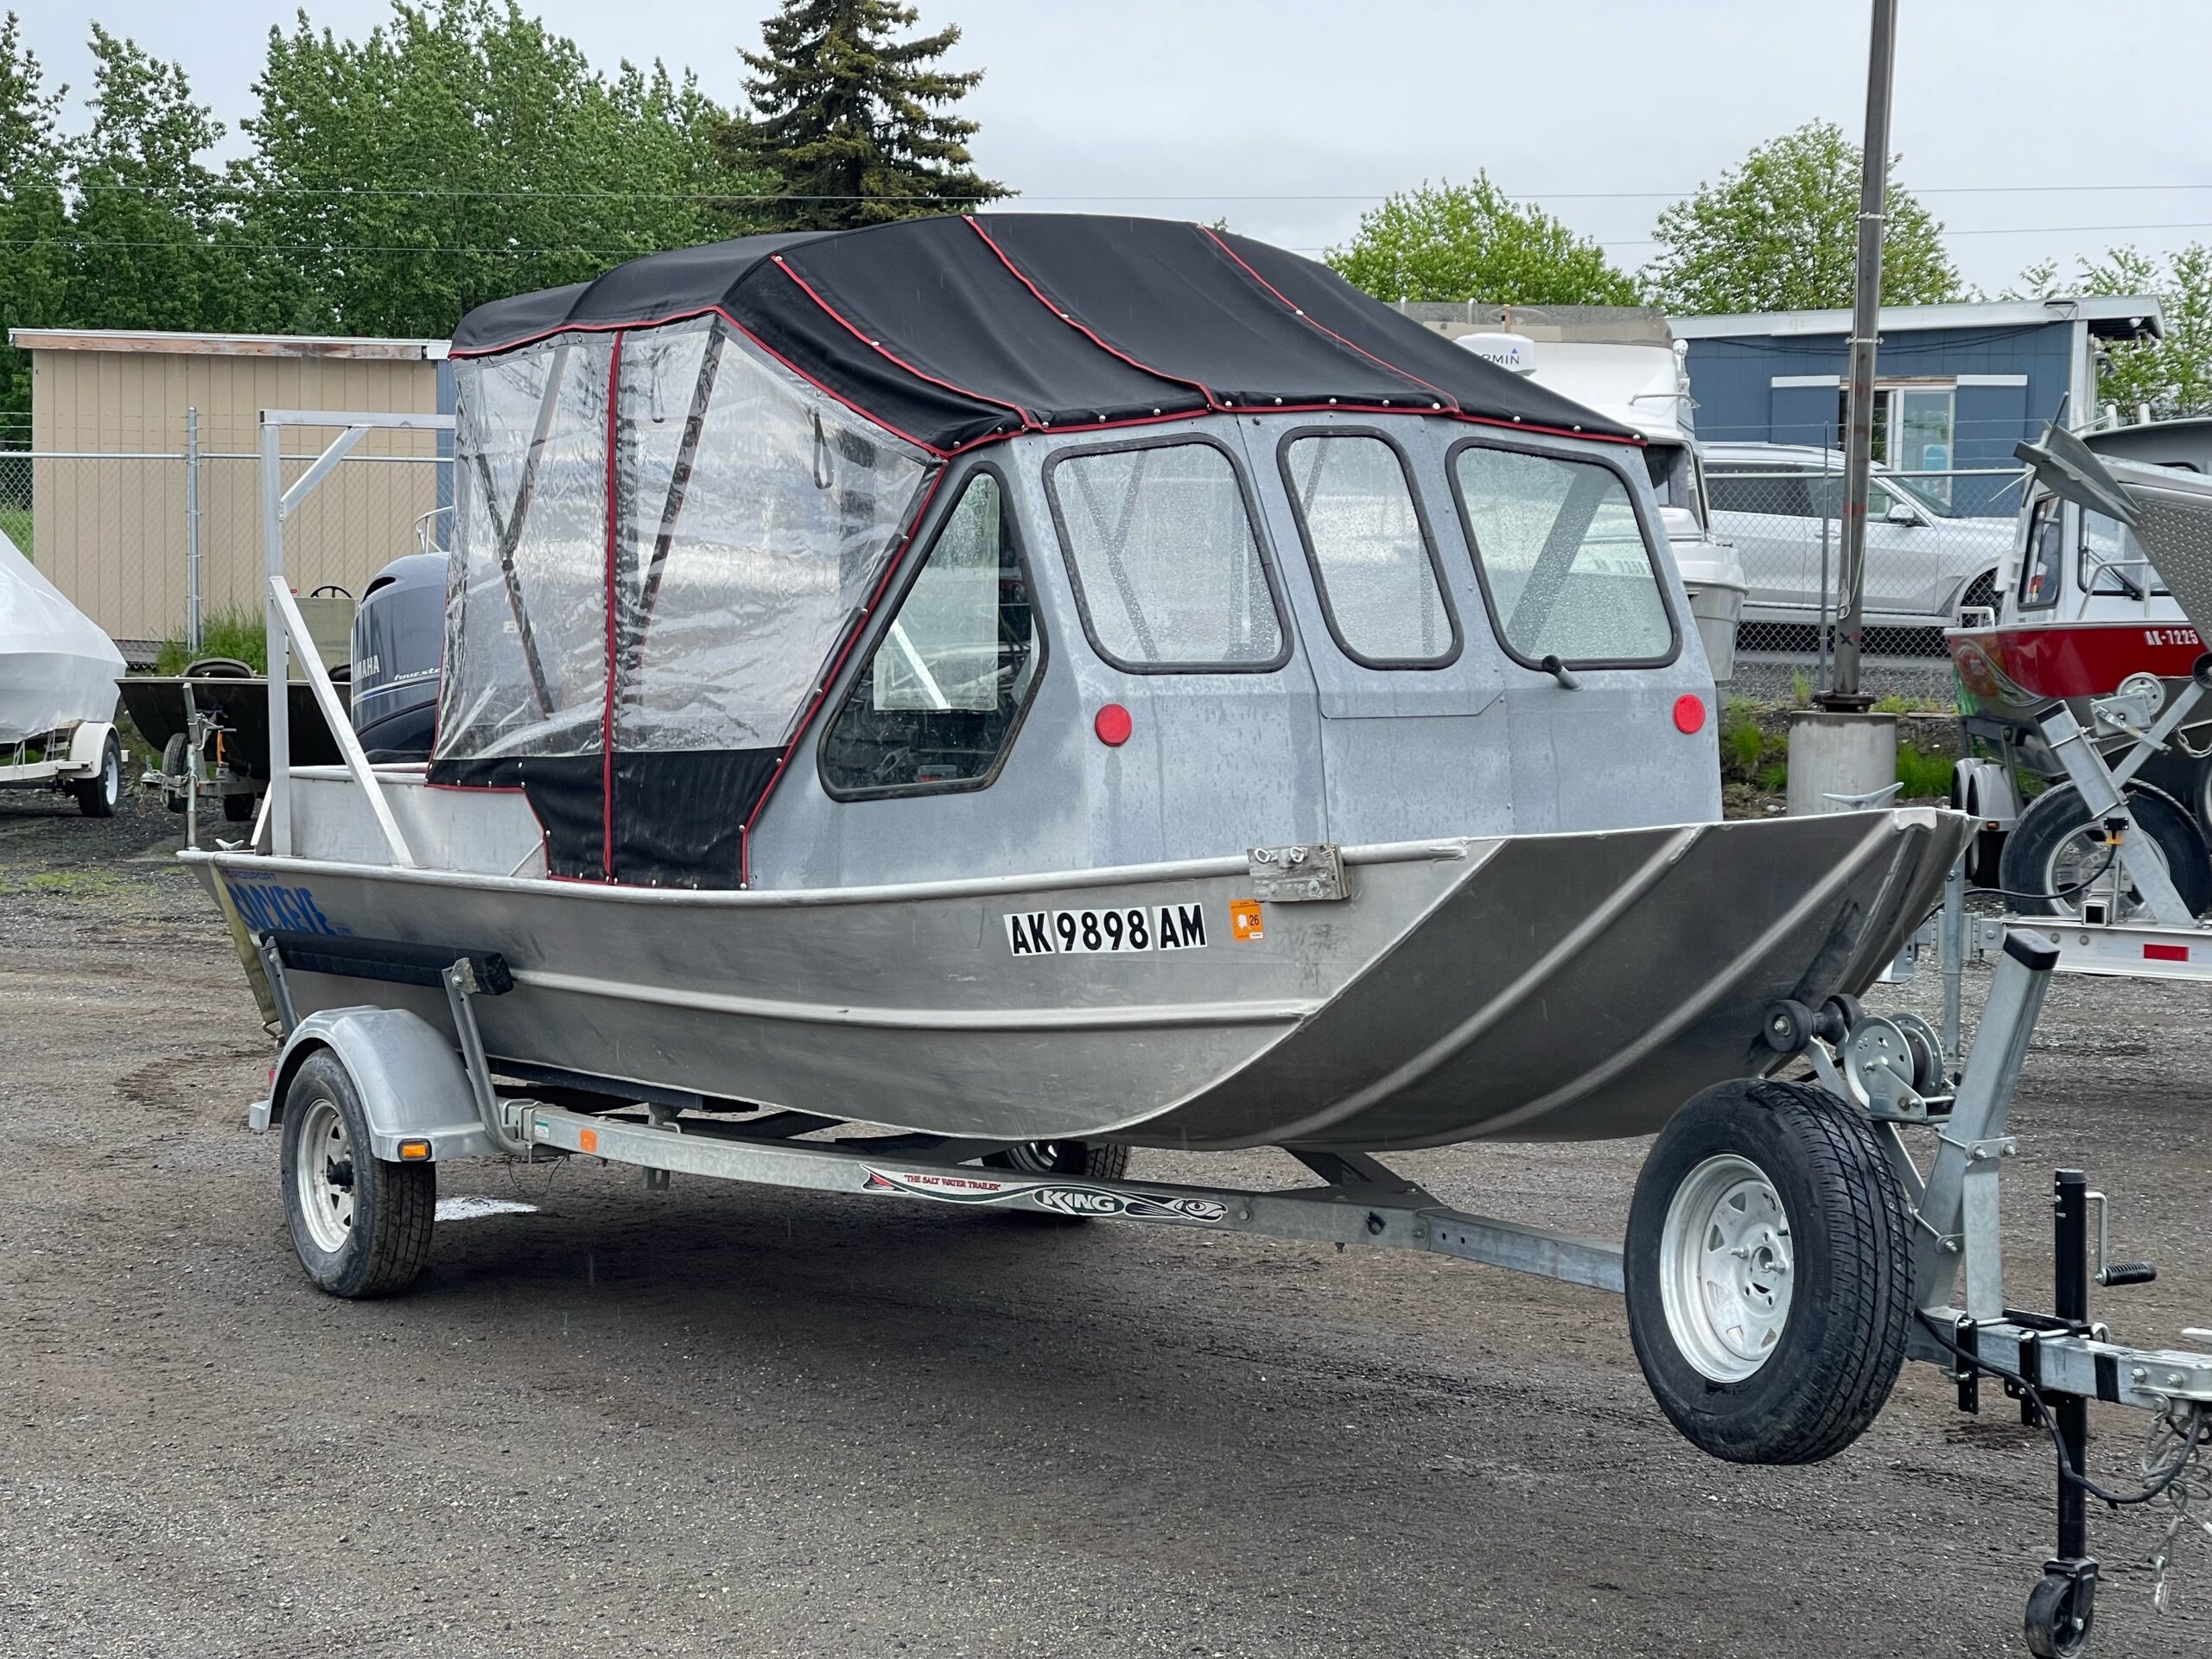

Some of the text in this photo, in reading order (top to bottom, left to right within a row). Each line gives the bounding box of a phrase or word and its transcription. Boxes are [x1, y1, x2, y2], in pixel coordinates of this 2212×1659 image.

[1481, 353, 1520, 365] RMIN
[221, 869, 277, 881] YDROSPORT
[226, 883, 338, 936] SOCKEYE
[1249, 914, 1260, 926] 26
[1011, 904, 1207, 955] AK 9898 AM
[922, 1176, 940, 1185] SALT
[942, 1178, 967, 1188] WATER
[1042, 1190, 1116, 1216] KING
